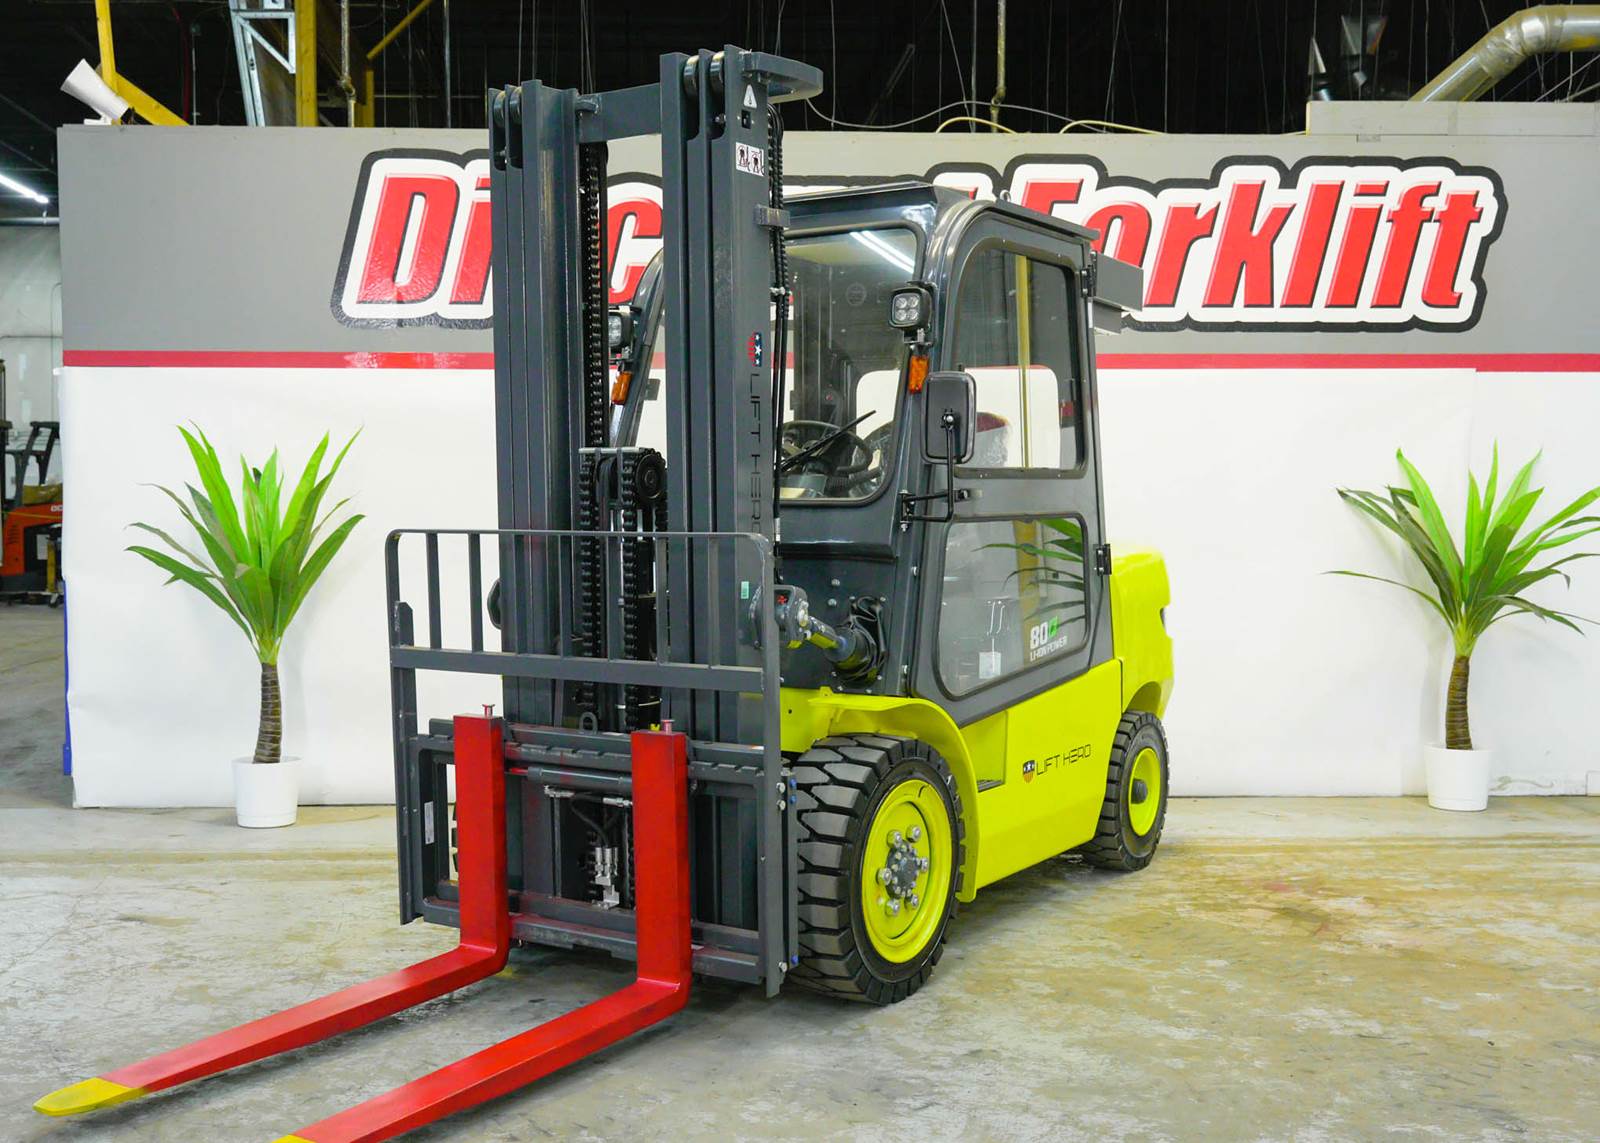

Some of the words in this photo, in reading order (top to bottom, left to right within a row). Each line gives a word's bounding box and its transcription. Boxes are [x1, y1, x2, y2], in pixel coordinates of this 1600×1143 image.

[750, 373, 761, 444] LIFT
[1036, 754, 1060, 776] LIFT
[1063, 743, 1091, 767] HERO
